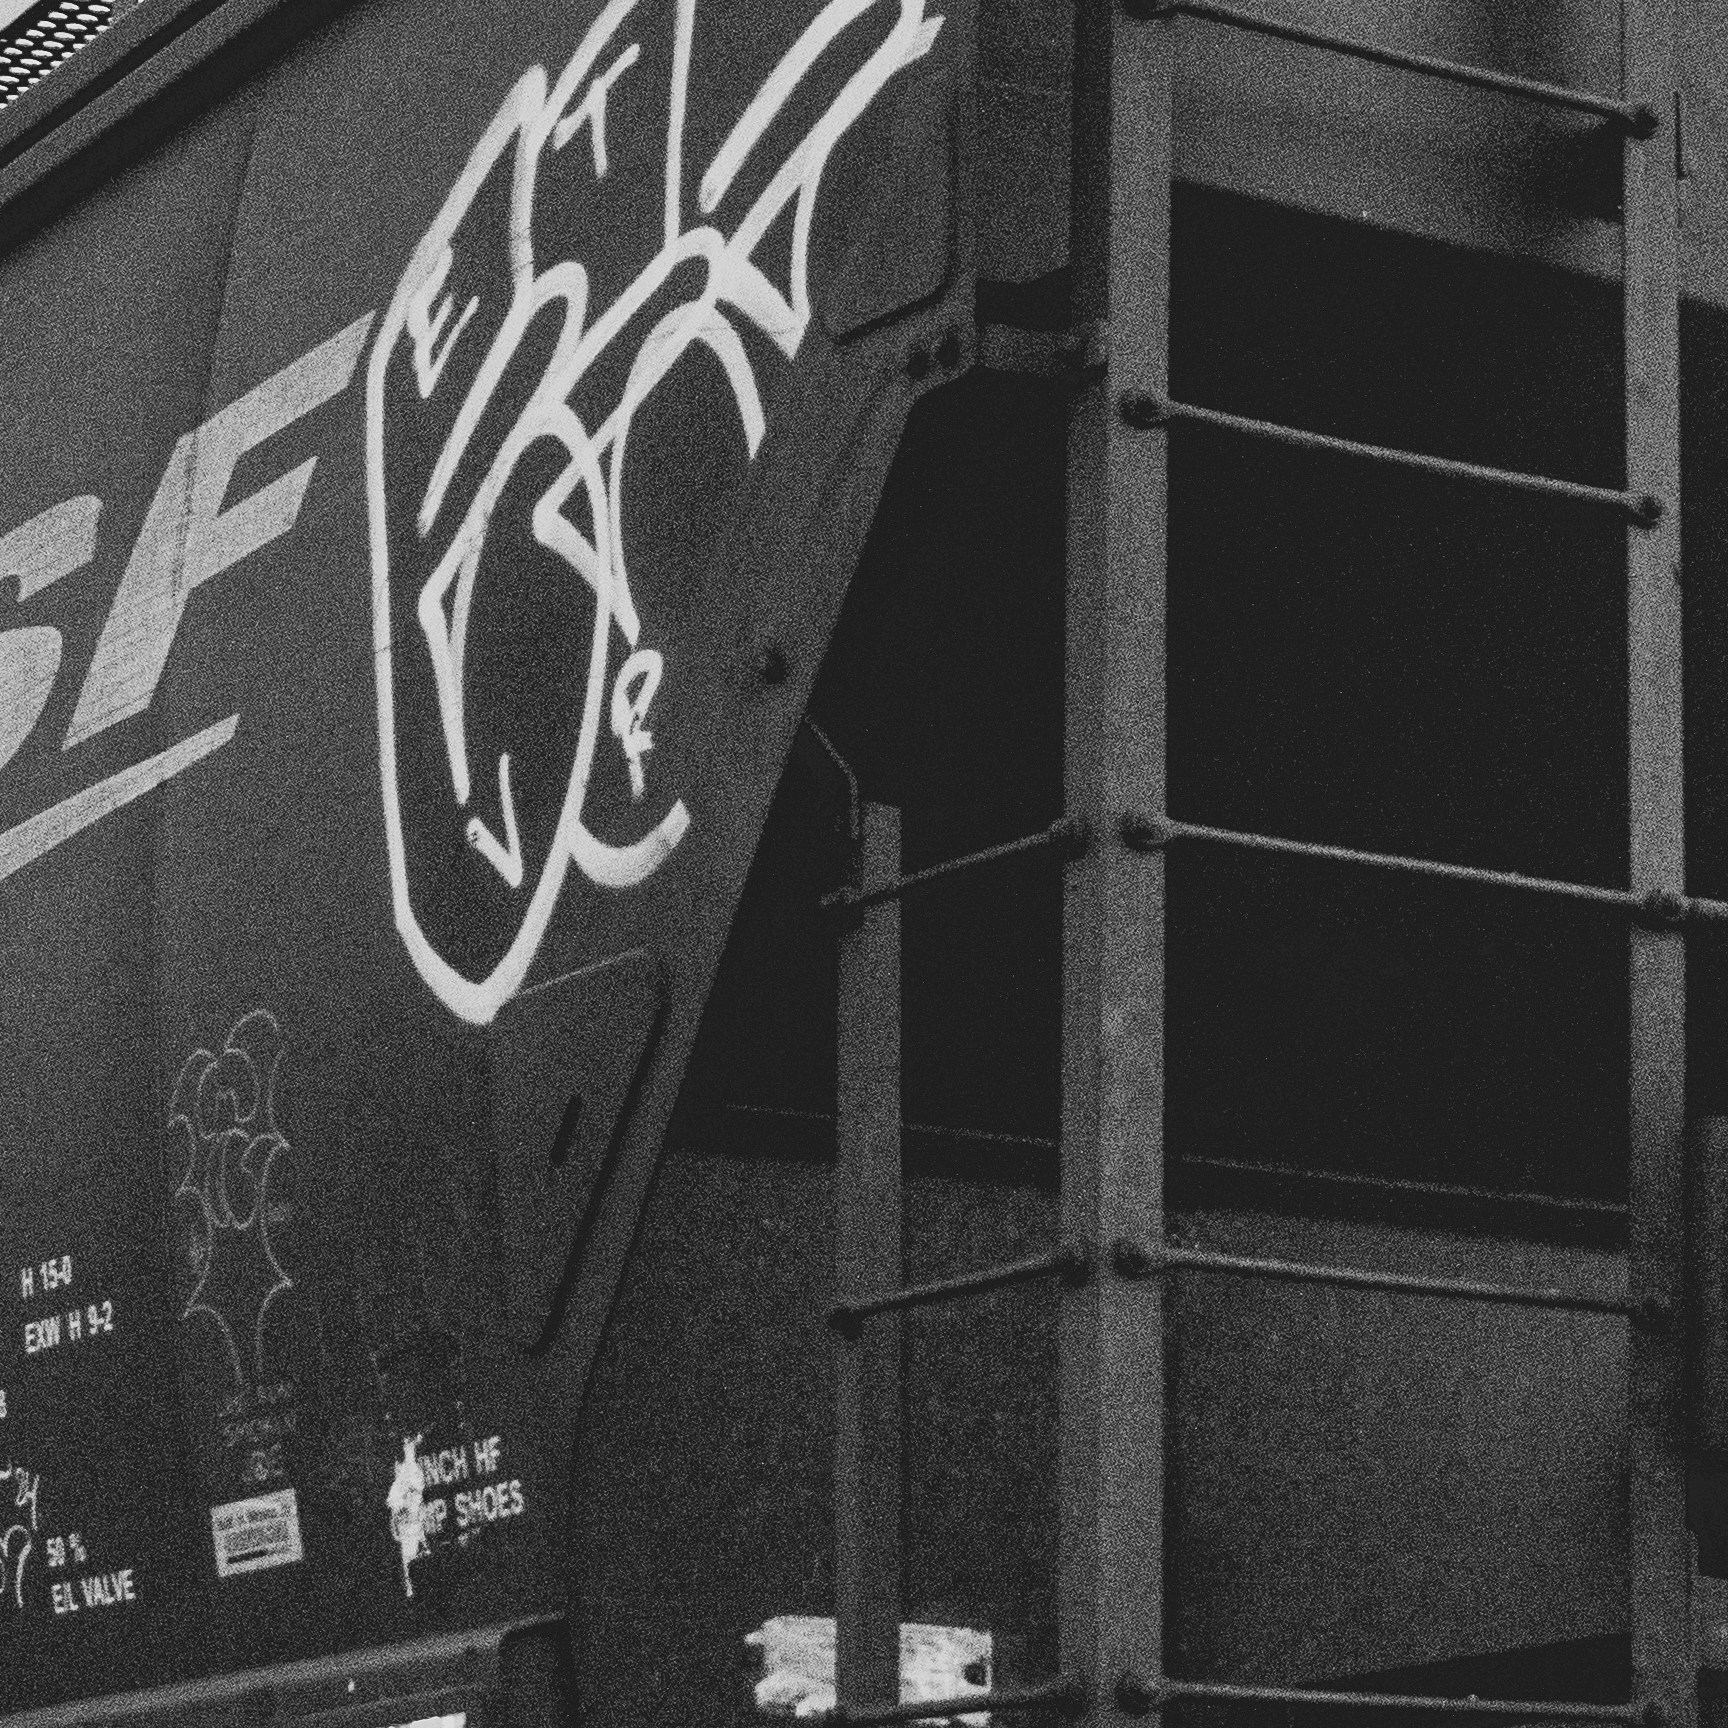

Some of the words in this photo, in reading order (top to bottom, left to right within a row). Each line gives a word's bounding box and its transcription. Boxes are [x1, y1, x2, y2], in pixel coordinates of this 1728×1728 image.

[21, 1266, 34, 1299] H
[68, 1309, 82, 1341] H
[454, 1479, 525, 1528] SHOES
[81, 1568, 136, 1608] VALVE
